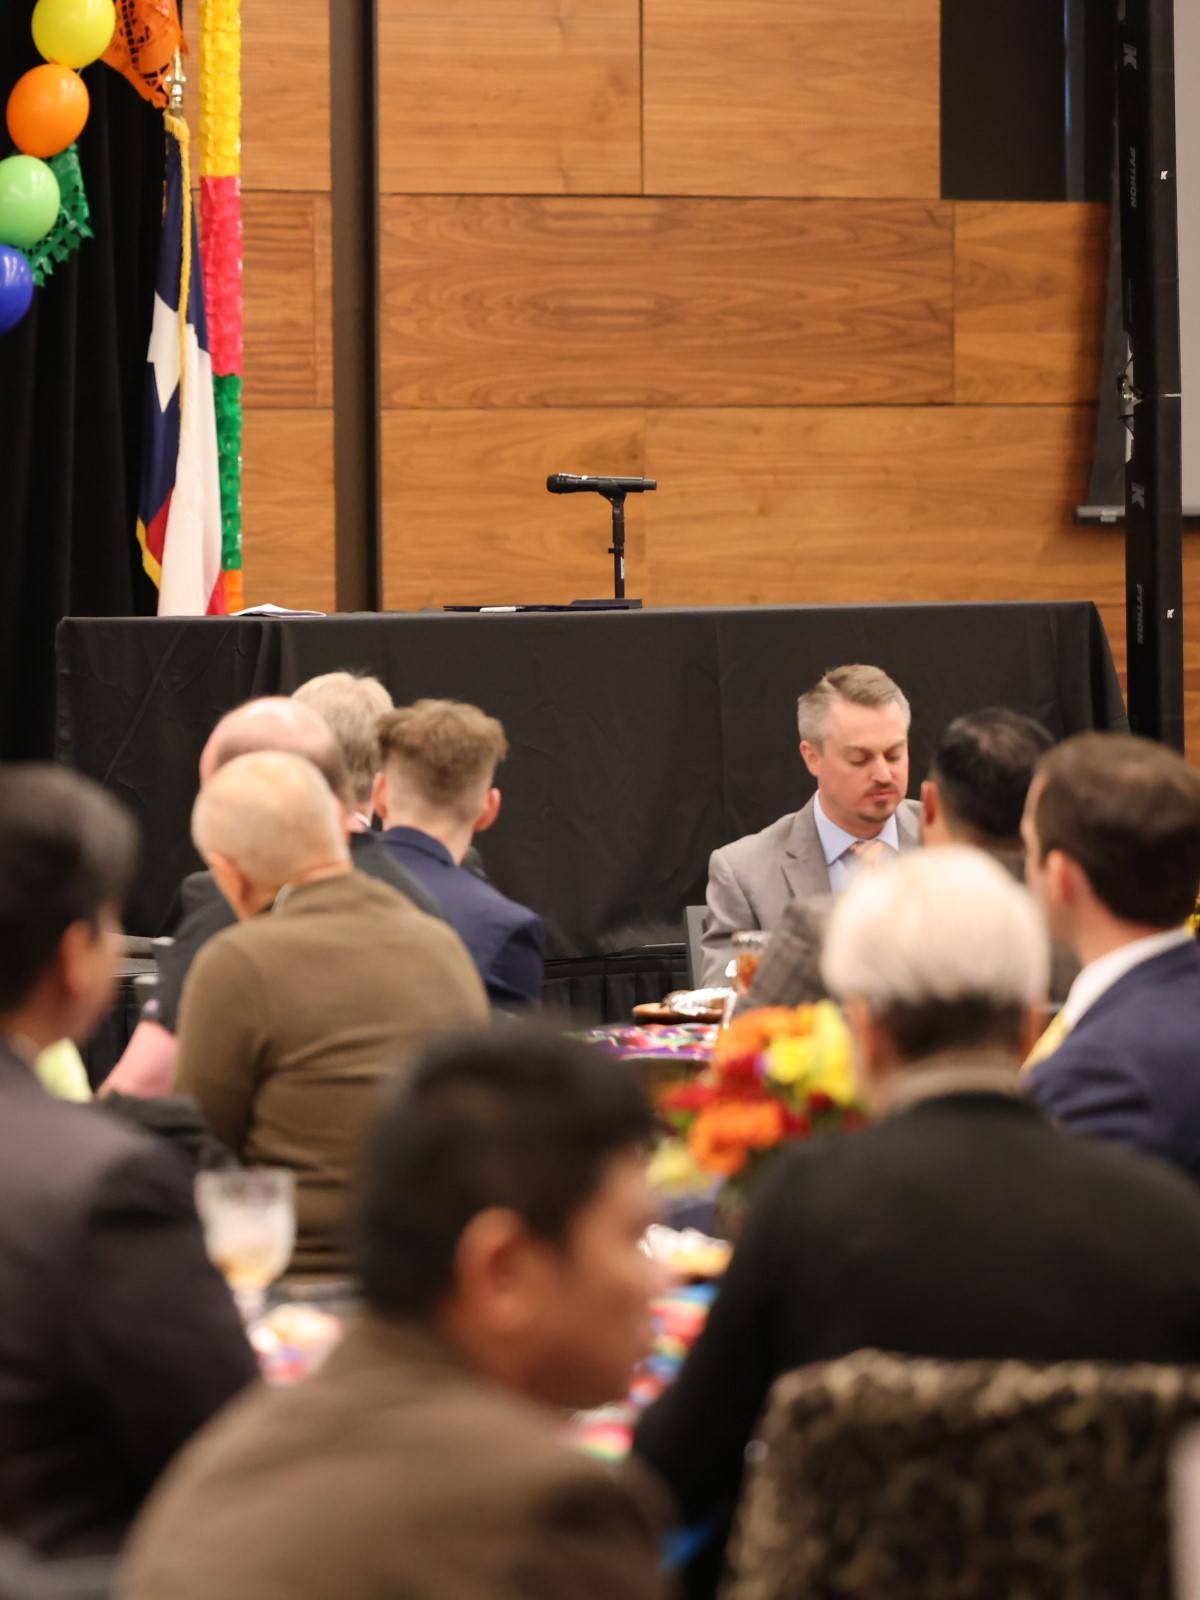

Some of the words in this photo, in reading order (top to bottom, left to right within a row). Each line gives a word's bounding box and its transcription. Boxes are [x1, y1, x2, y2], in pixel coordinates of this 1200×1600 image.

[1160, 170, 1168, 180] K
[1136, 584, 1144, 644] PYTHON
[1167, 609, 1174, 619] K
